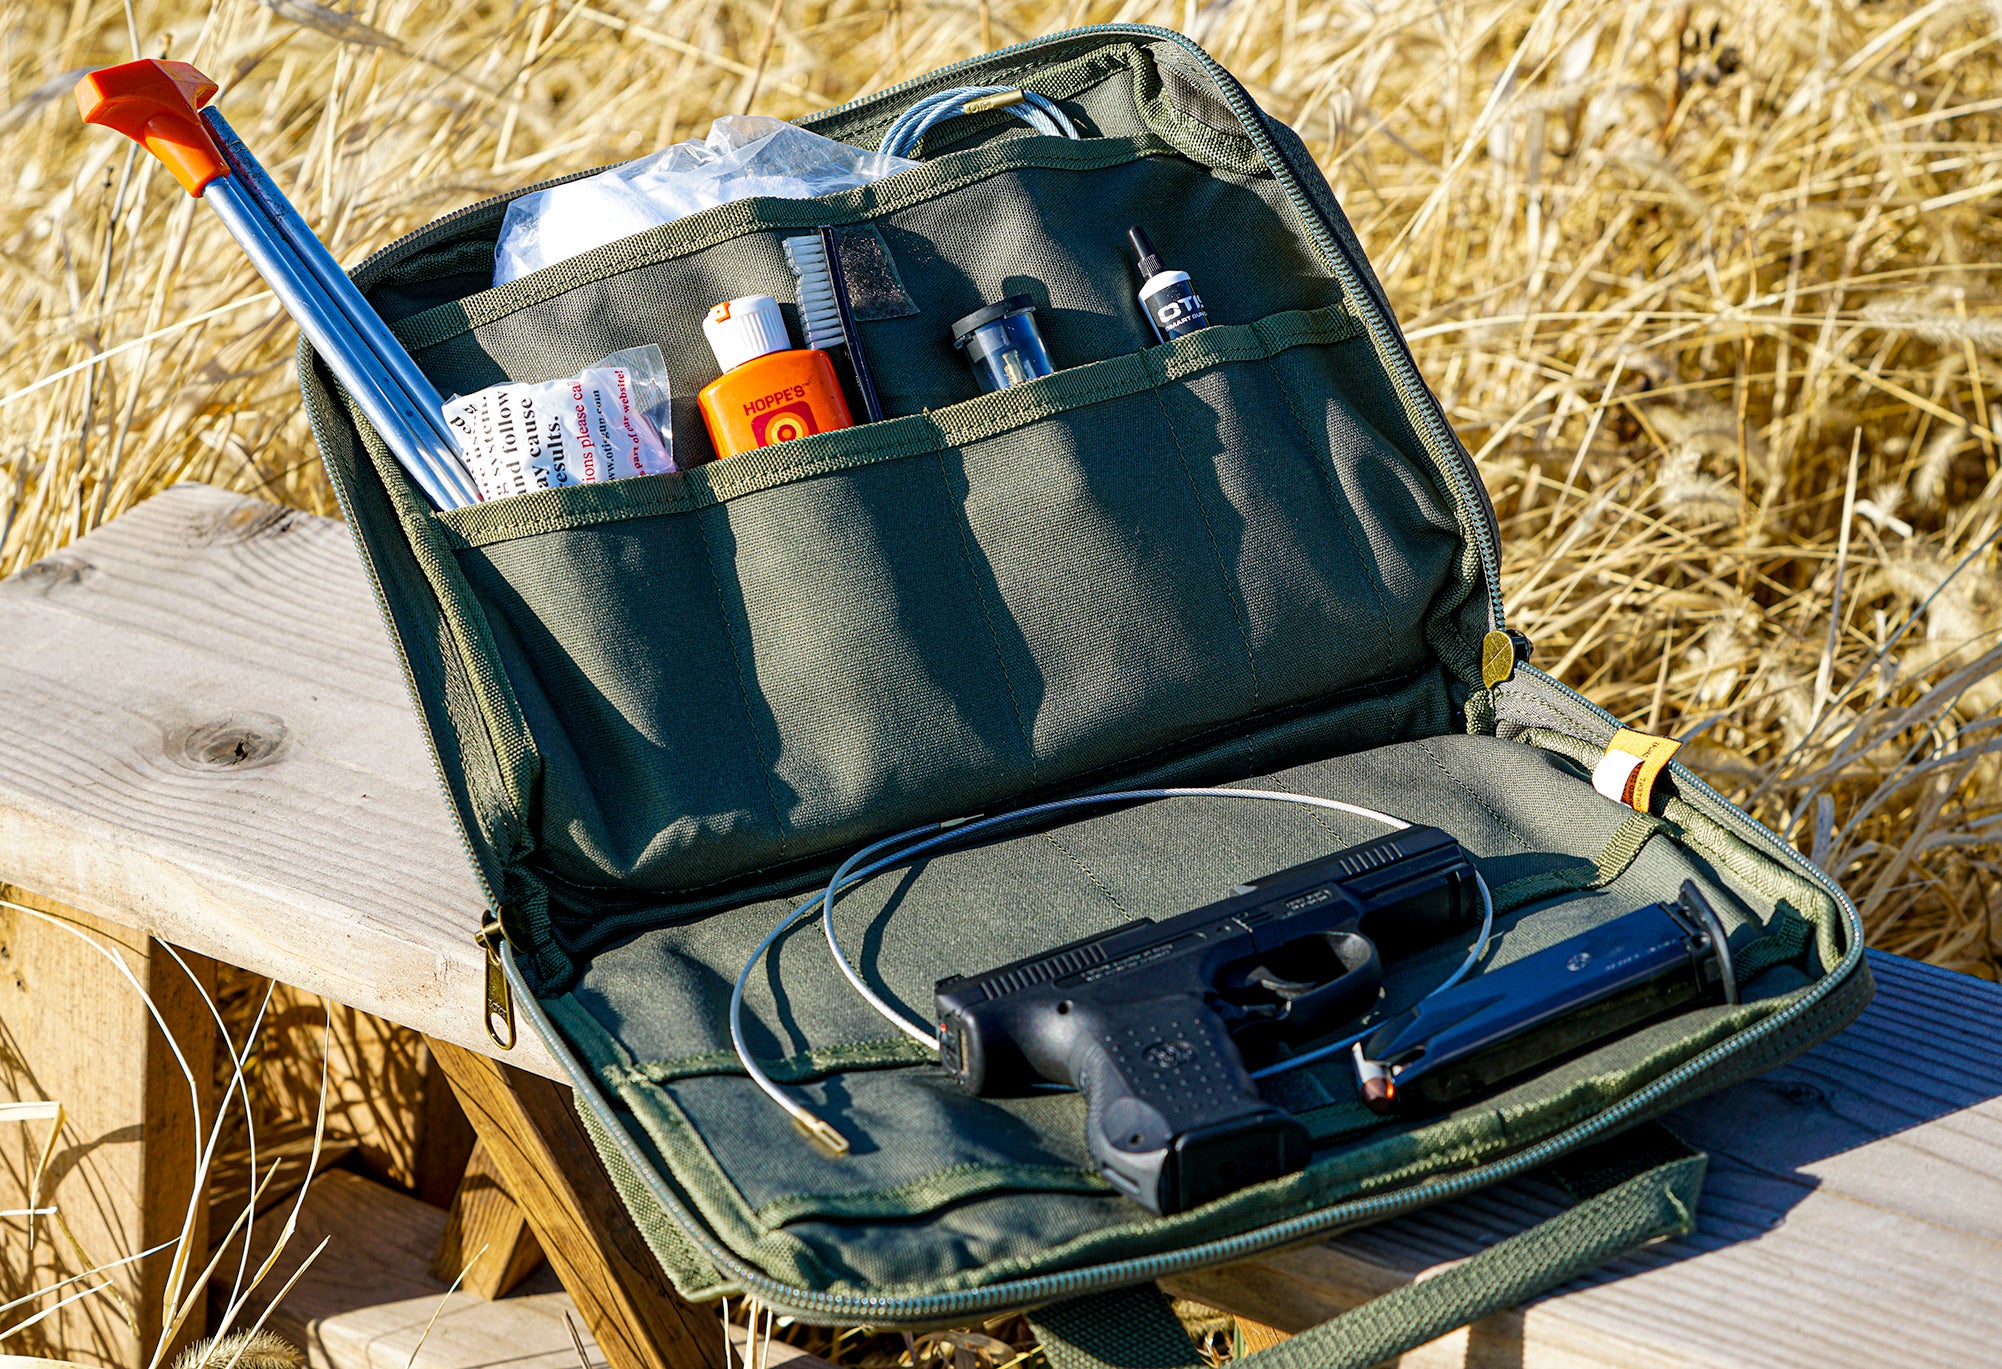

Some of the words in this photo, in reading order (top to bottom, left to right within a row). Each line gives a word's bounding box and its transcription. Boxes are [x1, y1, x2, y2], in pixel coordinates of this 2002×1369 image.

[613, 370, 631, 413] website!
[497, 390, 518, 454] follow
[520, 397, 541, 458] cause
[577, 404, 597, 449] please
[627, 433, 640, 444] of
[632, 446, 643, 469] part
